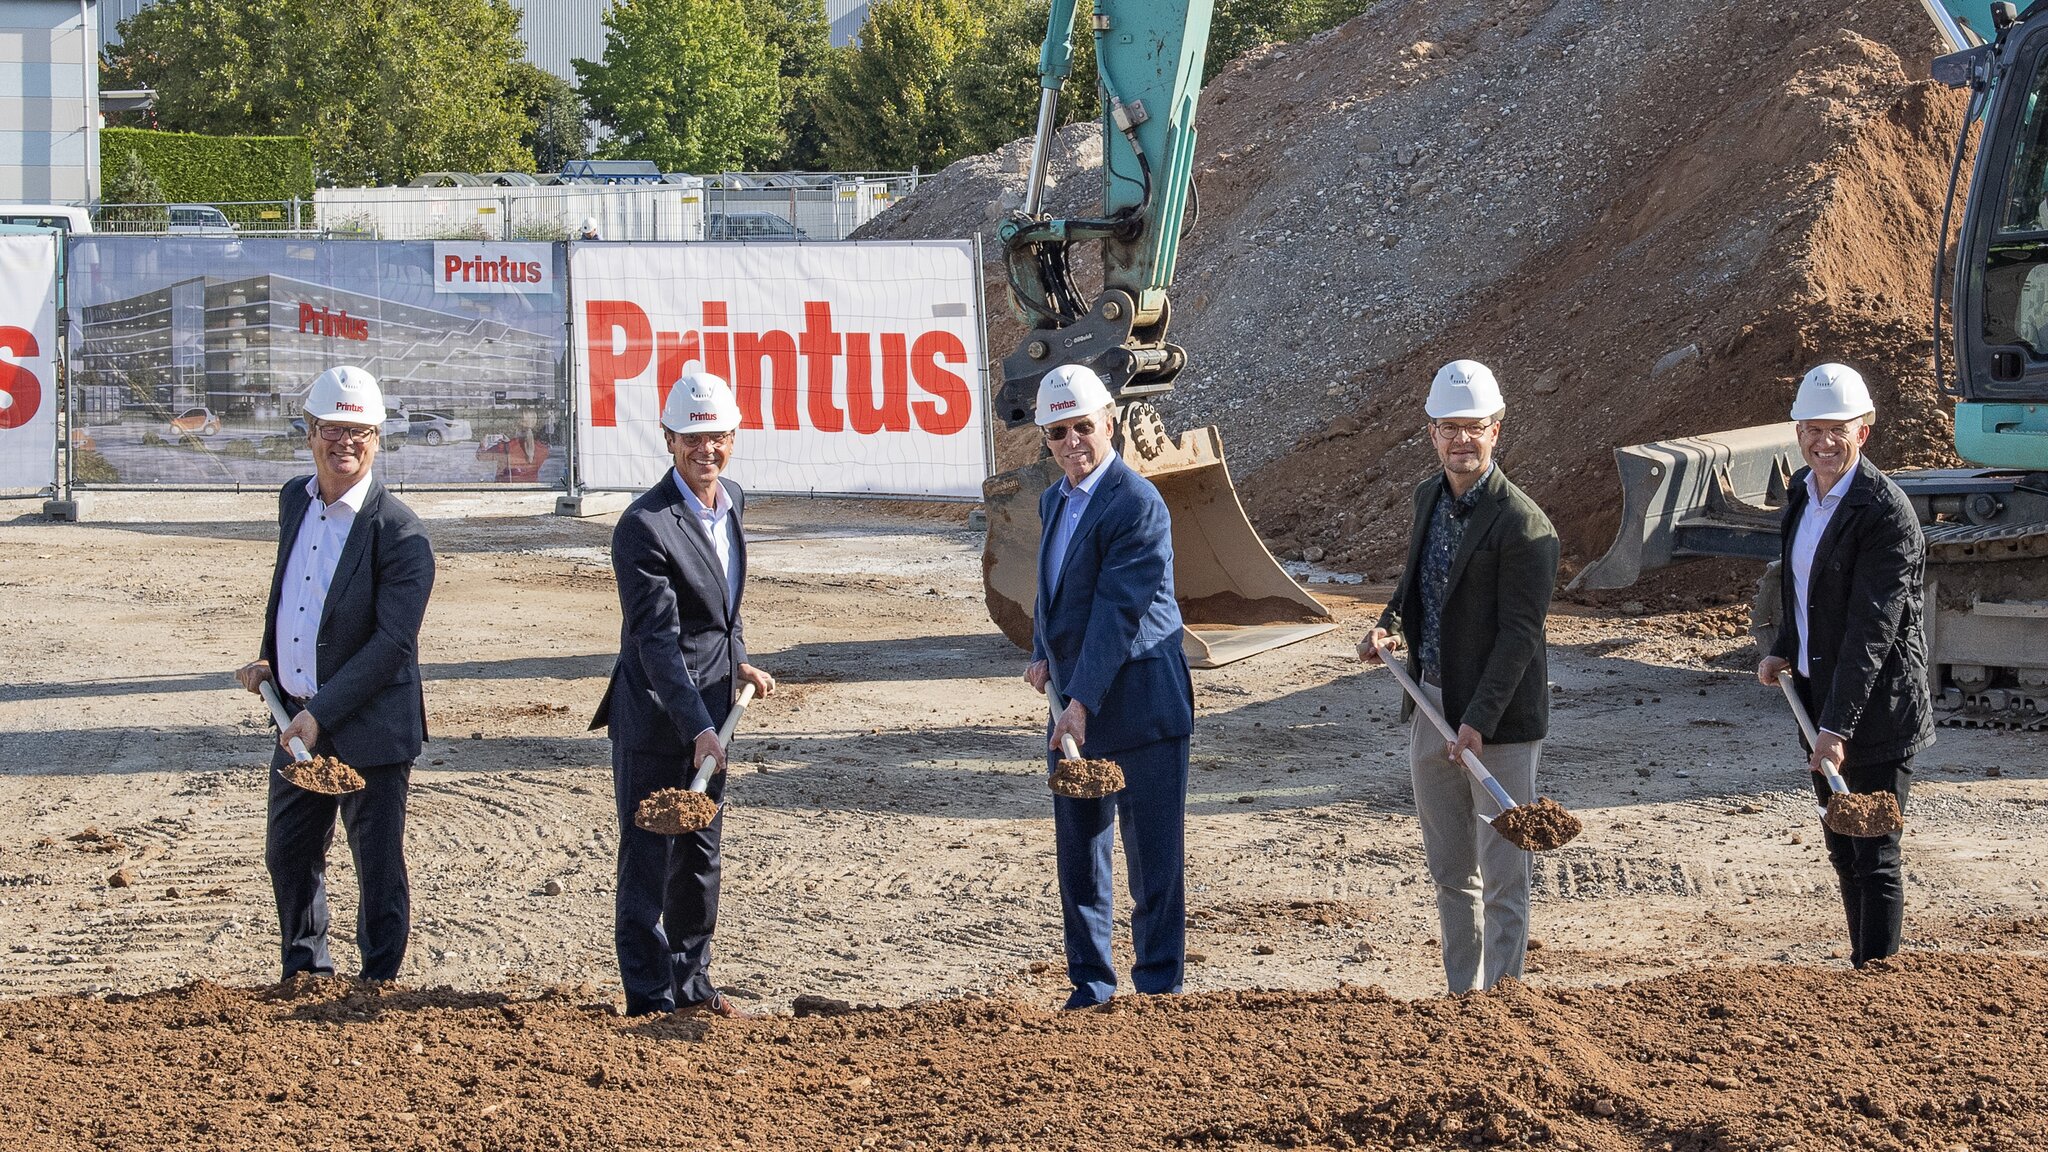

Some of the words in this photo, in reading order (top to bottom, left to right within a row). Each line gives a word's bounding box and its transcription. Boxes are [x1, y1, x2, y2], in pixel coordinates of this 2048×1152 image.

[445, 255, 541, 283] Printus
[299, 303, 369, 341] Printus
[586, 300, 972, 435] Printus
[336, 402, 363, 412] Printus
[1050, 400, 1076, 412] Printus
[690, 412, 717, 421] Printus
